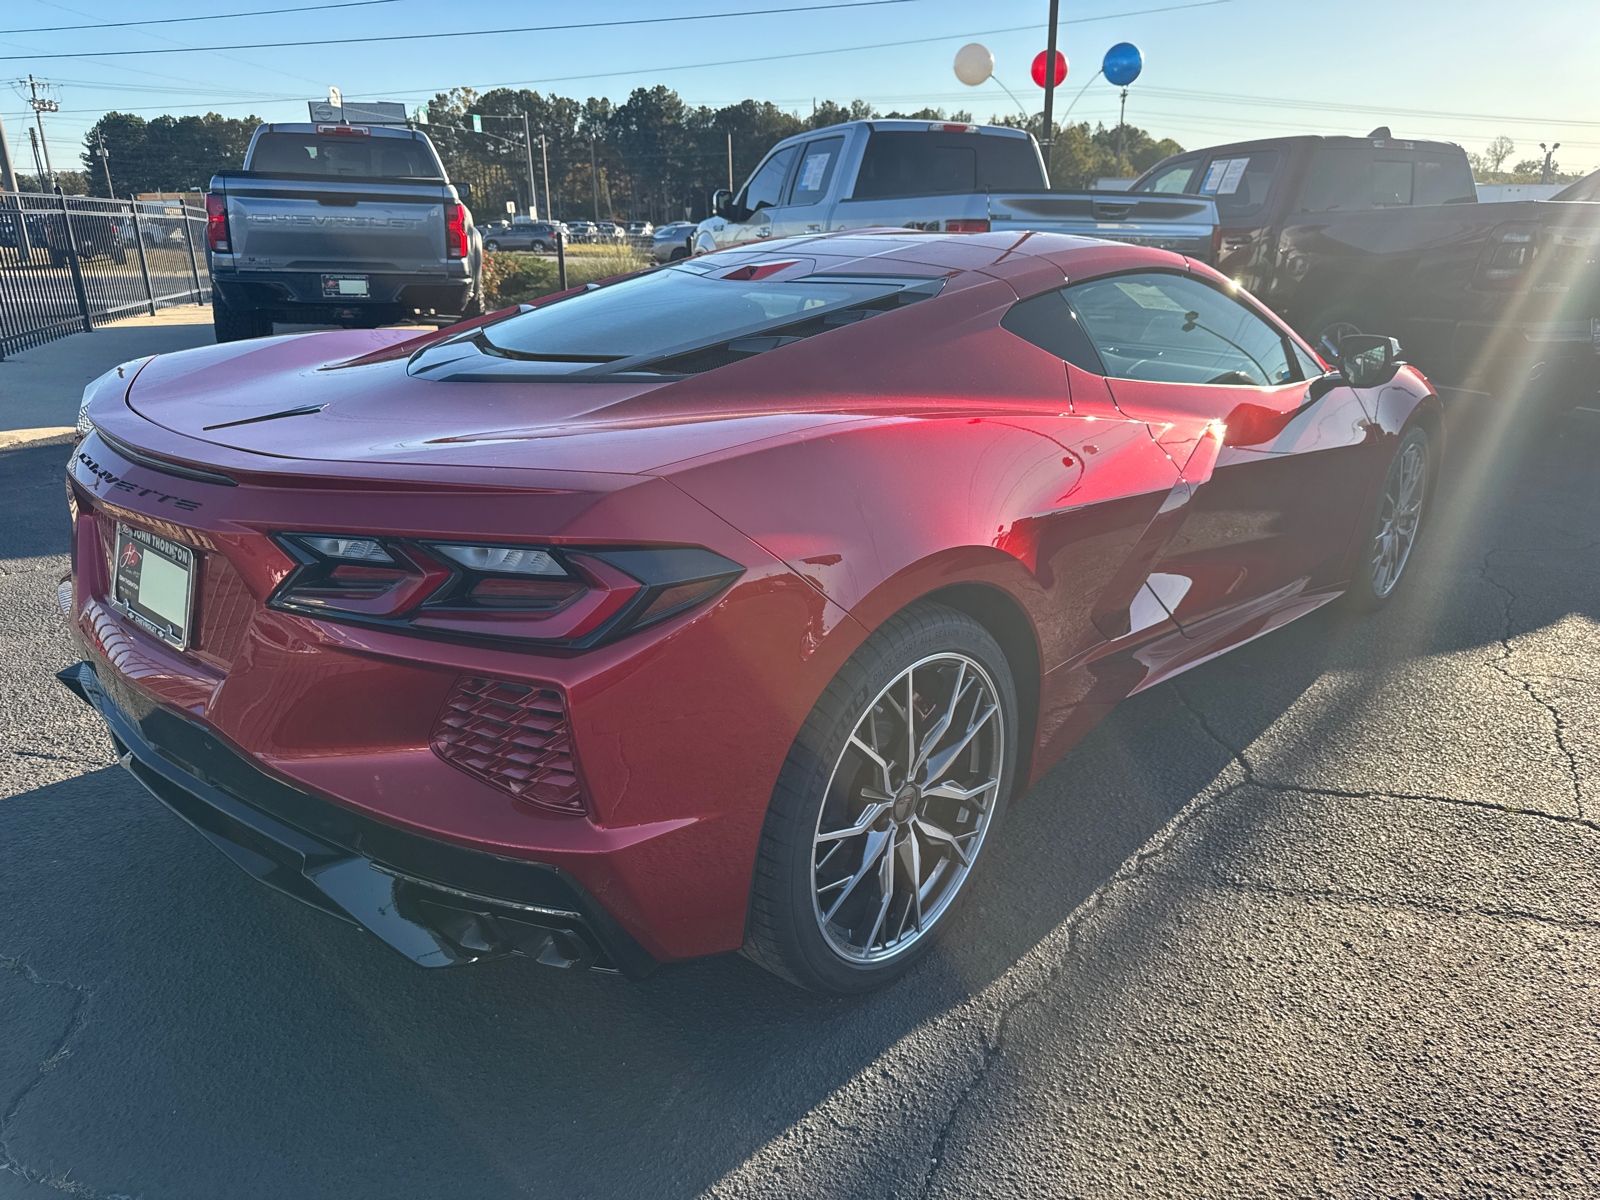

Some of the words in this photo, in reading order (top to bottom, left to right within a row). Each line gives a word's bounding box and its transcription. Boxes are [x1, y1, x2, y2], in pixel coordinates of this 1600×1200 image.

[251, 213, 423, 230] CHEVROLET
[78, 452, 203, 512] CORVETTE
[133, 529, 151, 544] JOHN
[134, 615, 157, 634] CHEVROLET
[872, 659, 892, 683] PILOT
[894, 640, 917, 662] SPORT
[919, 635, 933, 646] ALL
[934, 628, 960, 640] SEASON
[809, 684, 870, 795] MICHELIN
